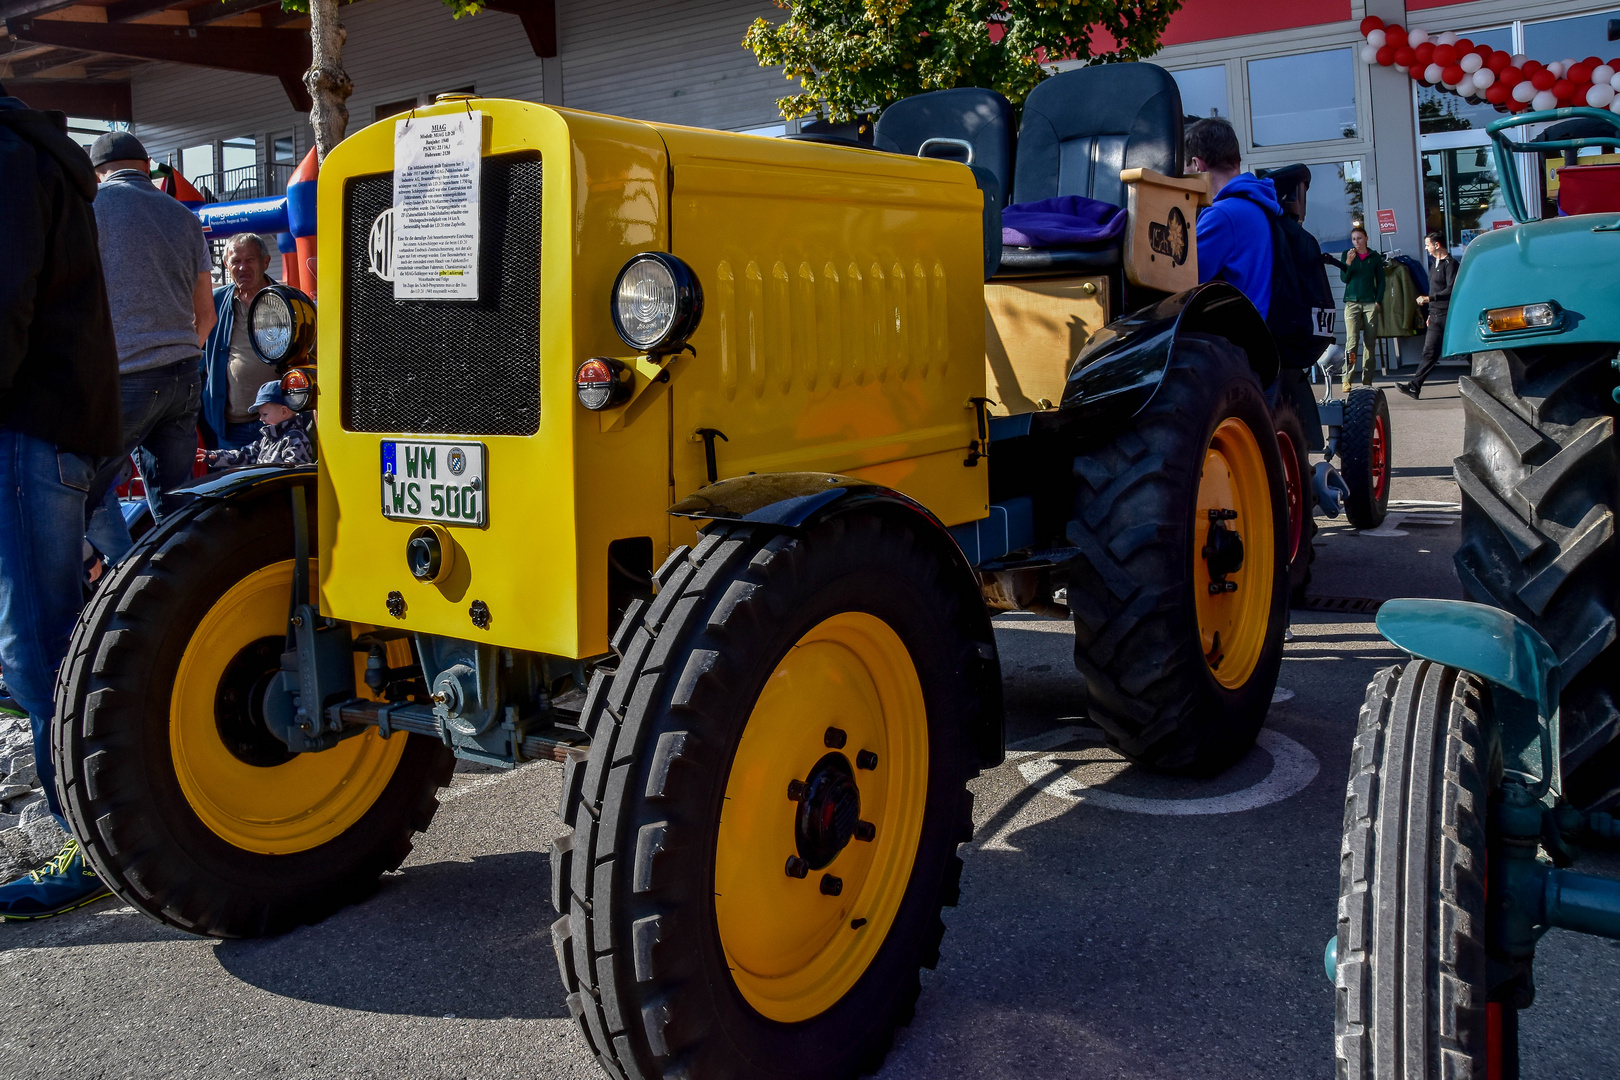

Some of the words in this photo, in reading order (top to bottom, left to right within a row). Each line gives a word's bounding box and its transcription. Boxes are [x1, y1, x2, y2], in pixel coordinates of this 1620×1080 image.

[387, 462, 392, 472] D
[405, 446, 436, 479] WM
[392, 482, 421, 515] WS
[430, 484, 476, 519] 500
